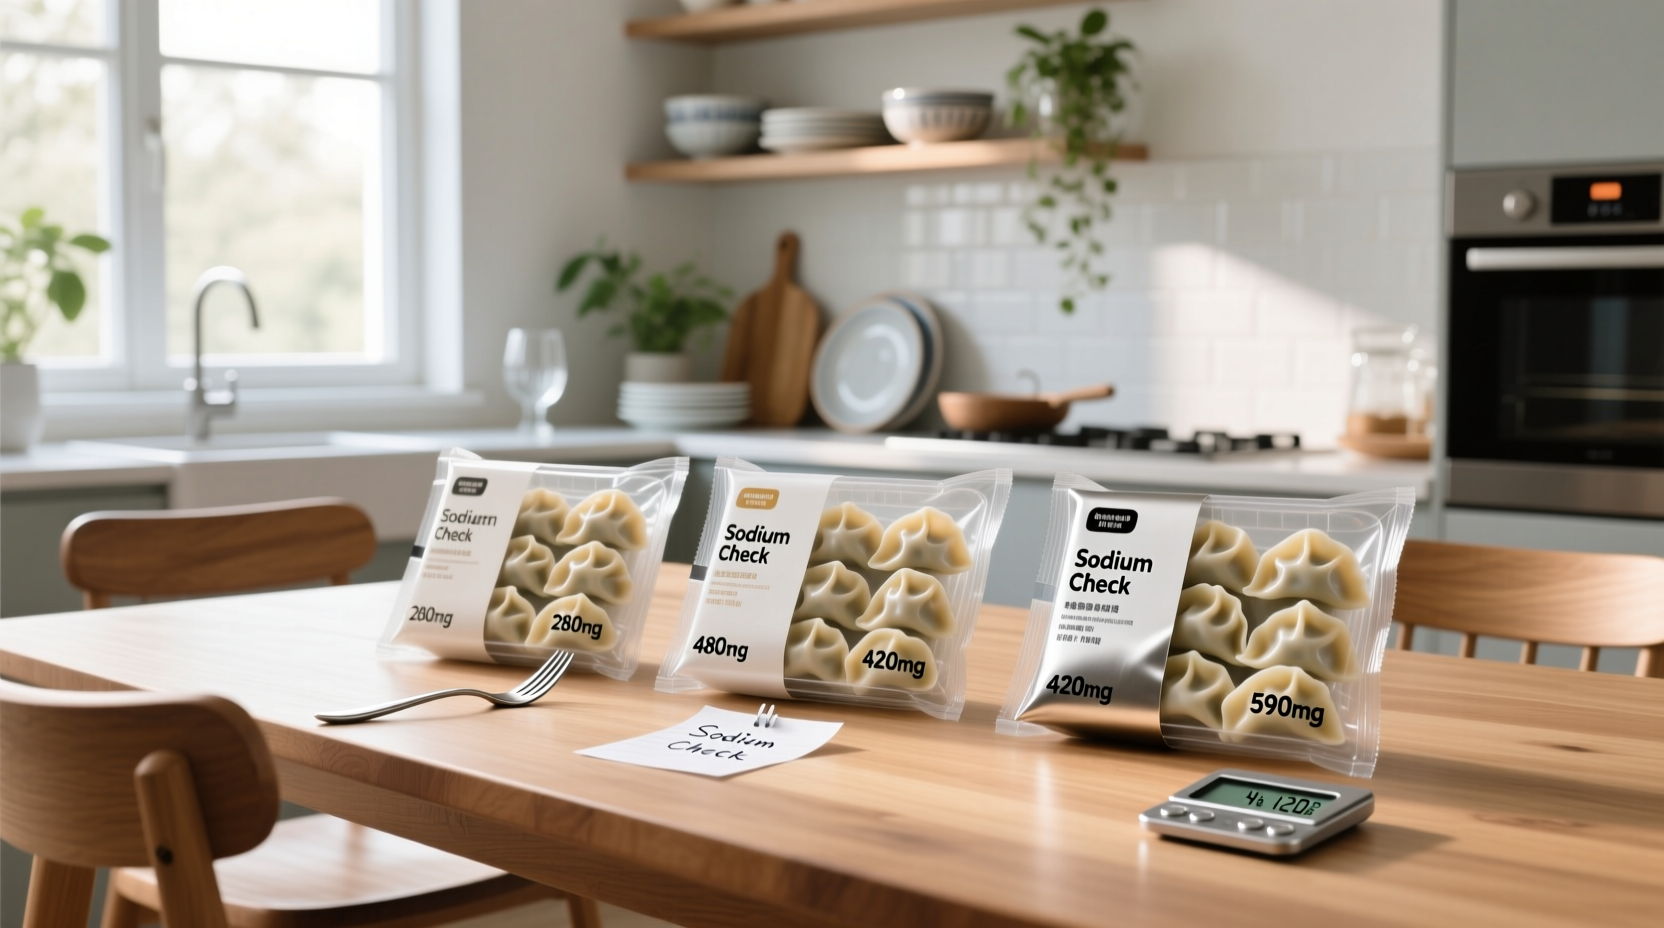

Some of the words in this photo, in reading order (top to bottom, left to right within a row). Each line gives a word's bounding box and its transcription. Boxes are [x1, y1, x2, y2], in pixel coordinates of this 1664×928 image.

[434, 526, 473, 543] Check
[724, 523, 791, 545] Sodium
[718, 543, 771, 565] Check
[1074, 548, 1153, 573] Sodium
[1069, 572, 1132, 596] Check
[551, 613, 603, 641] 280ng
[692, 635, 749, 663] 480ng
[862, 649, 926, 680] 420mg
[1045, 674, 1114, 706] 420mg
[1249, 692, 1325, 727] 590mg
[667, 740, 747, 761] Check
